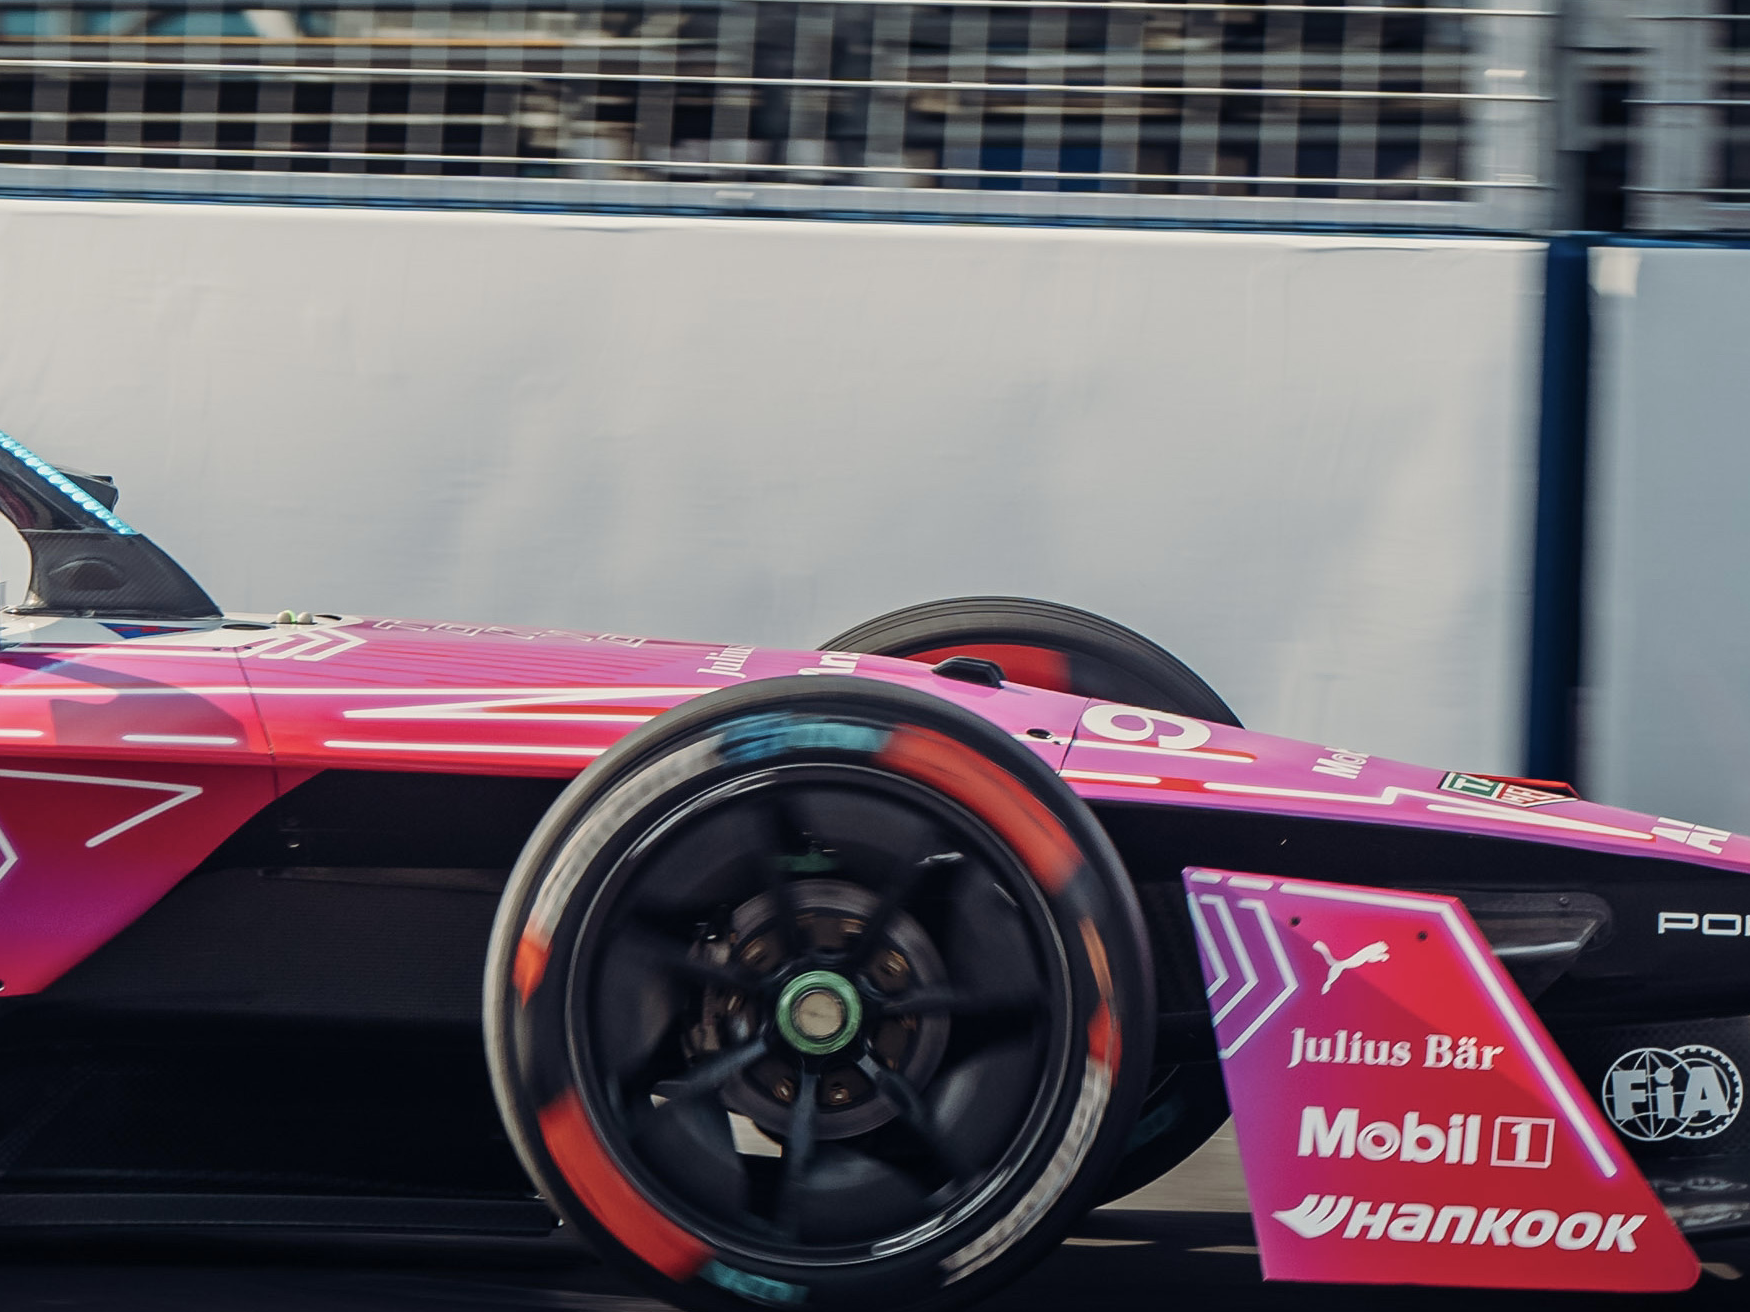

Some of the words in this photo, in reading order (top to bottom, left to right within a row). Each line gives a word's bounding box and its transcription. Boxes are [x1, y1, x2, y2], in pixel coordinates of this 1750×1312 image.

[1286, 1027, 1412, 1070] Julius
[1422, 1033, 1505, 1071] Bär
[1296, 1105, 1484, 1165] Mobil
